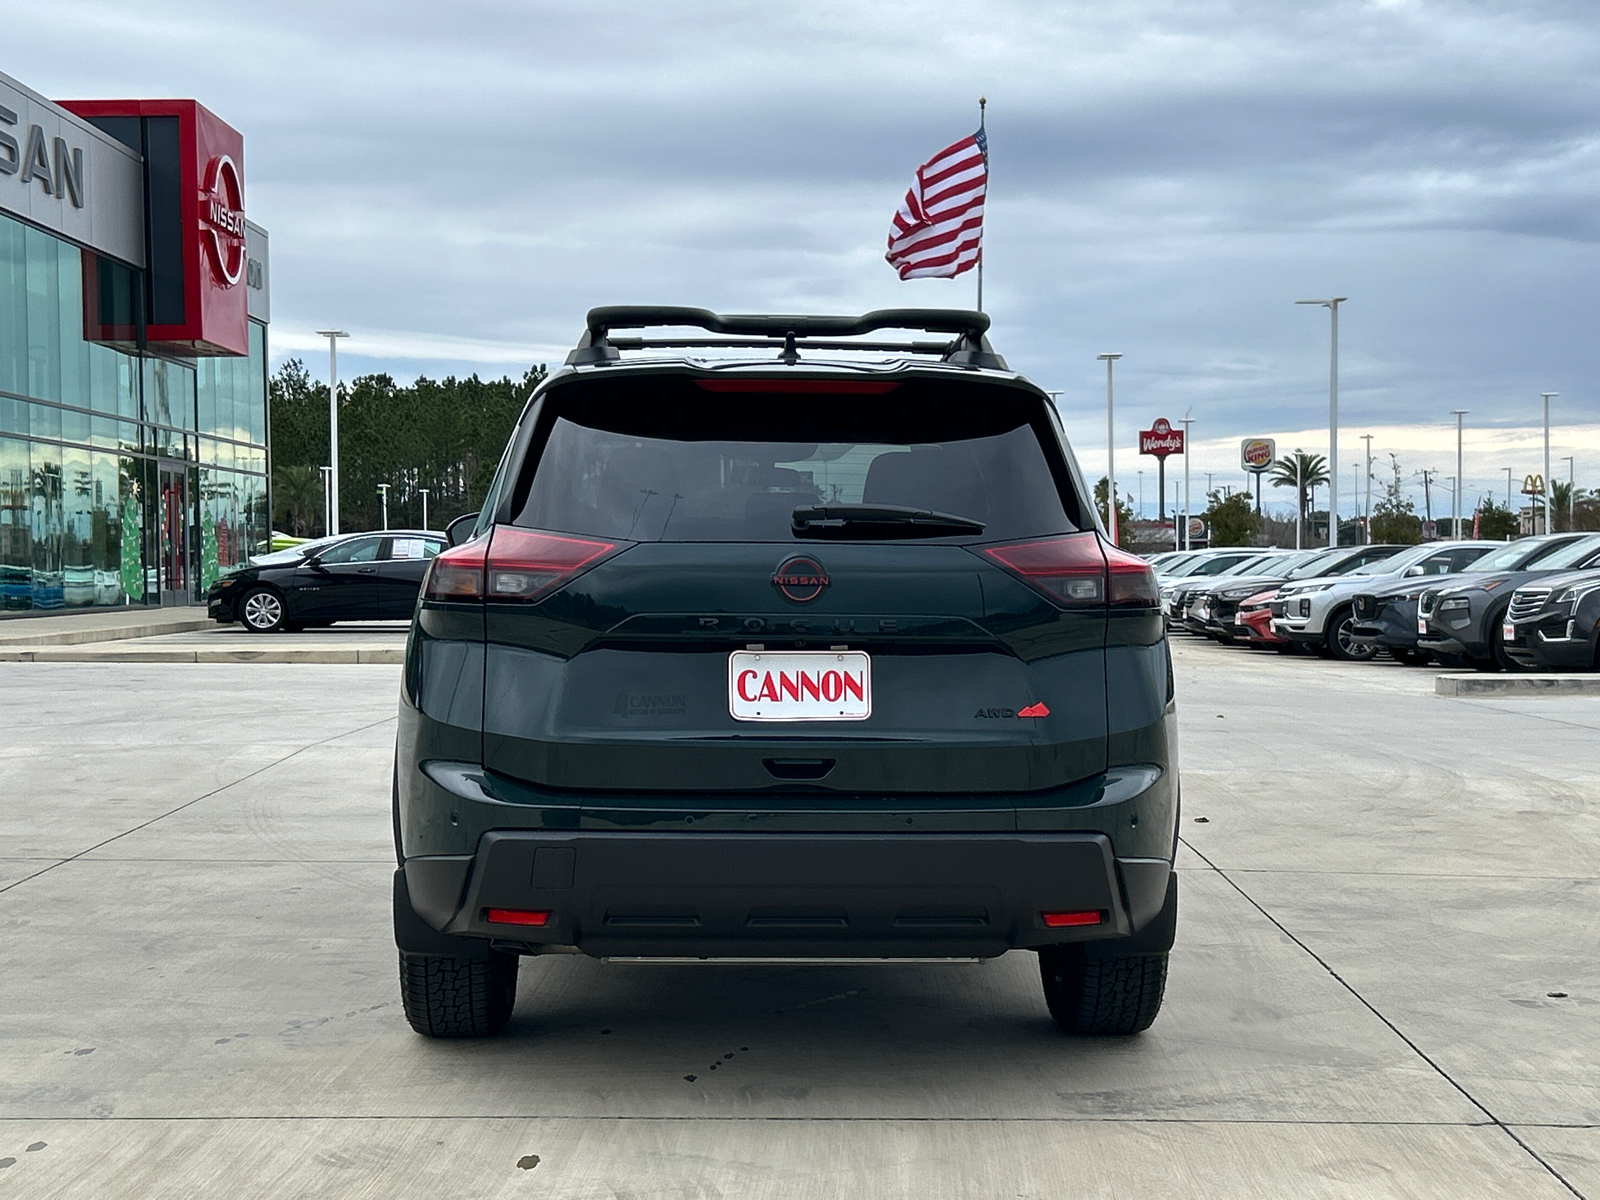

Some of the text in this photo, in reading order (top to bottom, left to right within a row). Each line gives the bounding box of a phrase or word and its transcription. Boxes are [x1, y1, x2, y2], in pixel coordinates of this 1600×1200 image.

[209, 199, 246, 239] NISSAN
[1143, 434, 1182, 452] Wendy's
[1246, 444, 1270, 456] BURGER
[1247, 450, 1271, 463] KING
[773, 576, 830, 586] NISSAN
[699, 617, 899, 633] ROGUE
[736, 669, 863, 702] CANNON
[973, 707, 1016, 719] AWD
